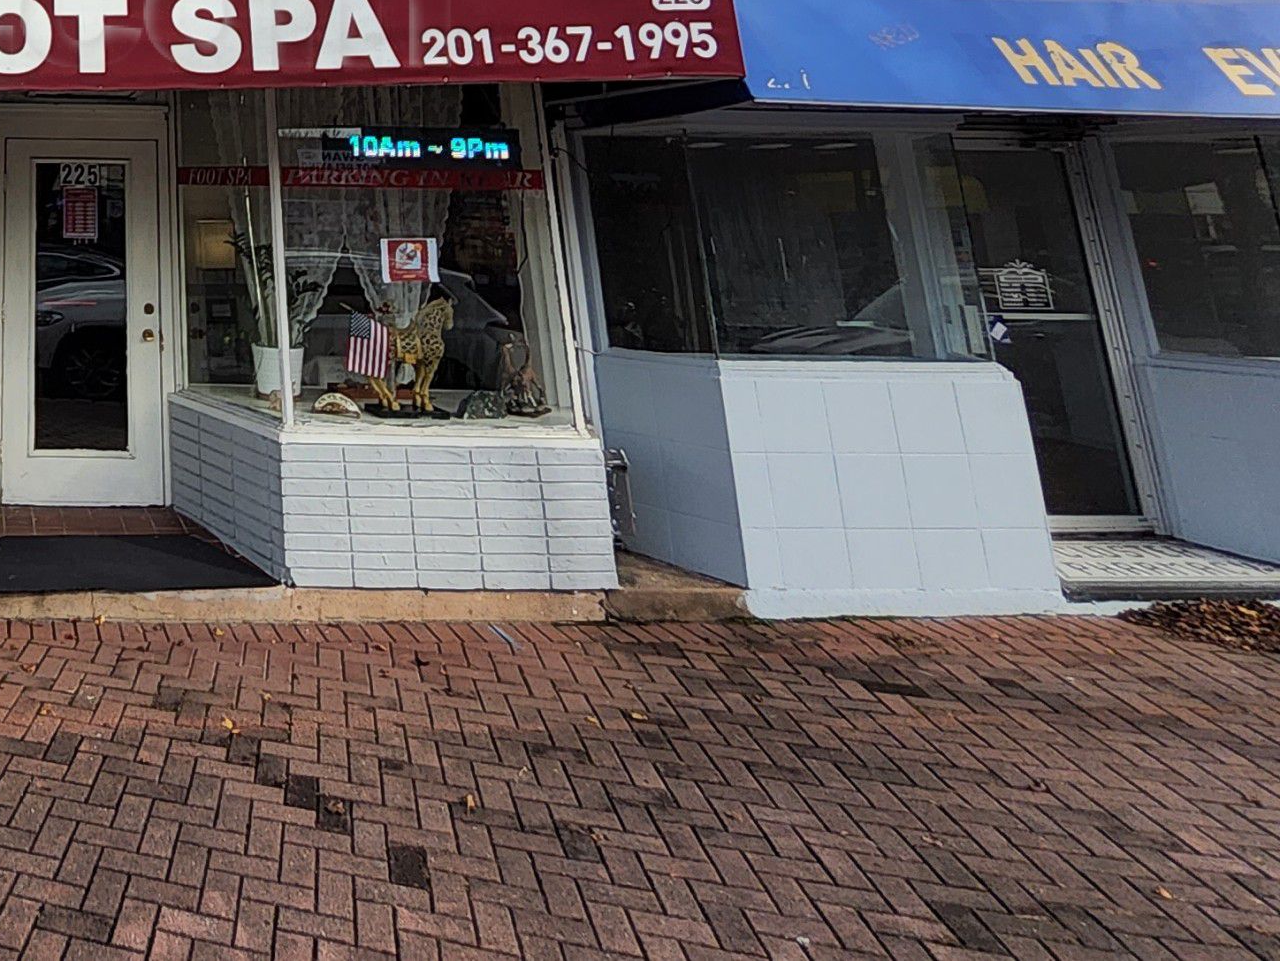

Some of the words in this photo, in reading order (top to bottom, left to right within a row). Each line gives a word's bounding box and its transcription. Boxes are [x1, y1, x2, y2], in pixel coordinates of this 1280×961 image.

[421, 22, 717, 65] 201-367-1995
[991, 37, 1162, 90] HAIR
[349, 135, 421, 158] 10Am
[451, 138, 510, 159] 9Pm
[61, 164, 98, 185] 225
[189, 168, 225, 186] FOOT
[227, 168, 252, 186] SPA
[284, 169, 410, 186] PARKING
[417, 170, 450, 186] IN
[460, 170, 532, 187] AR
[1051, 545, 1206, 558] CLOSTER
[1061, 561, 1269, 575] PHARMACY
